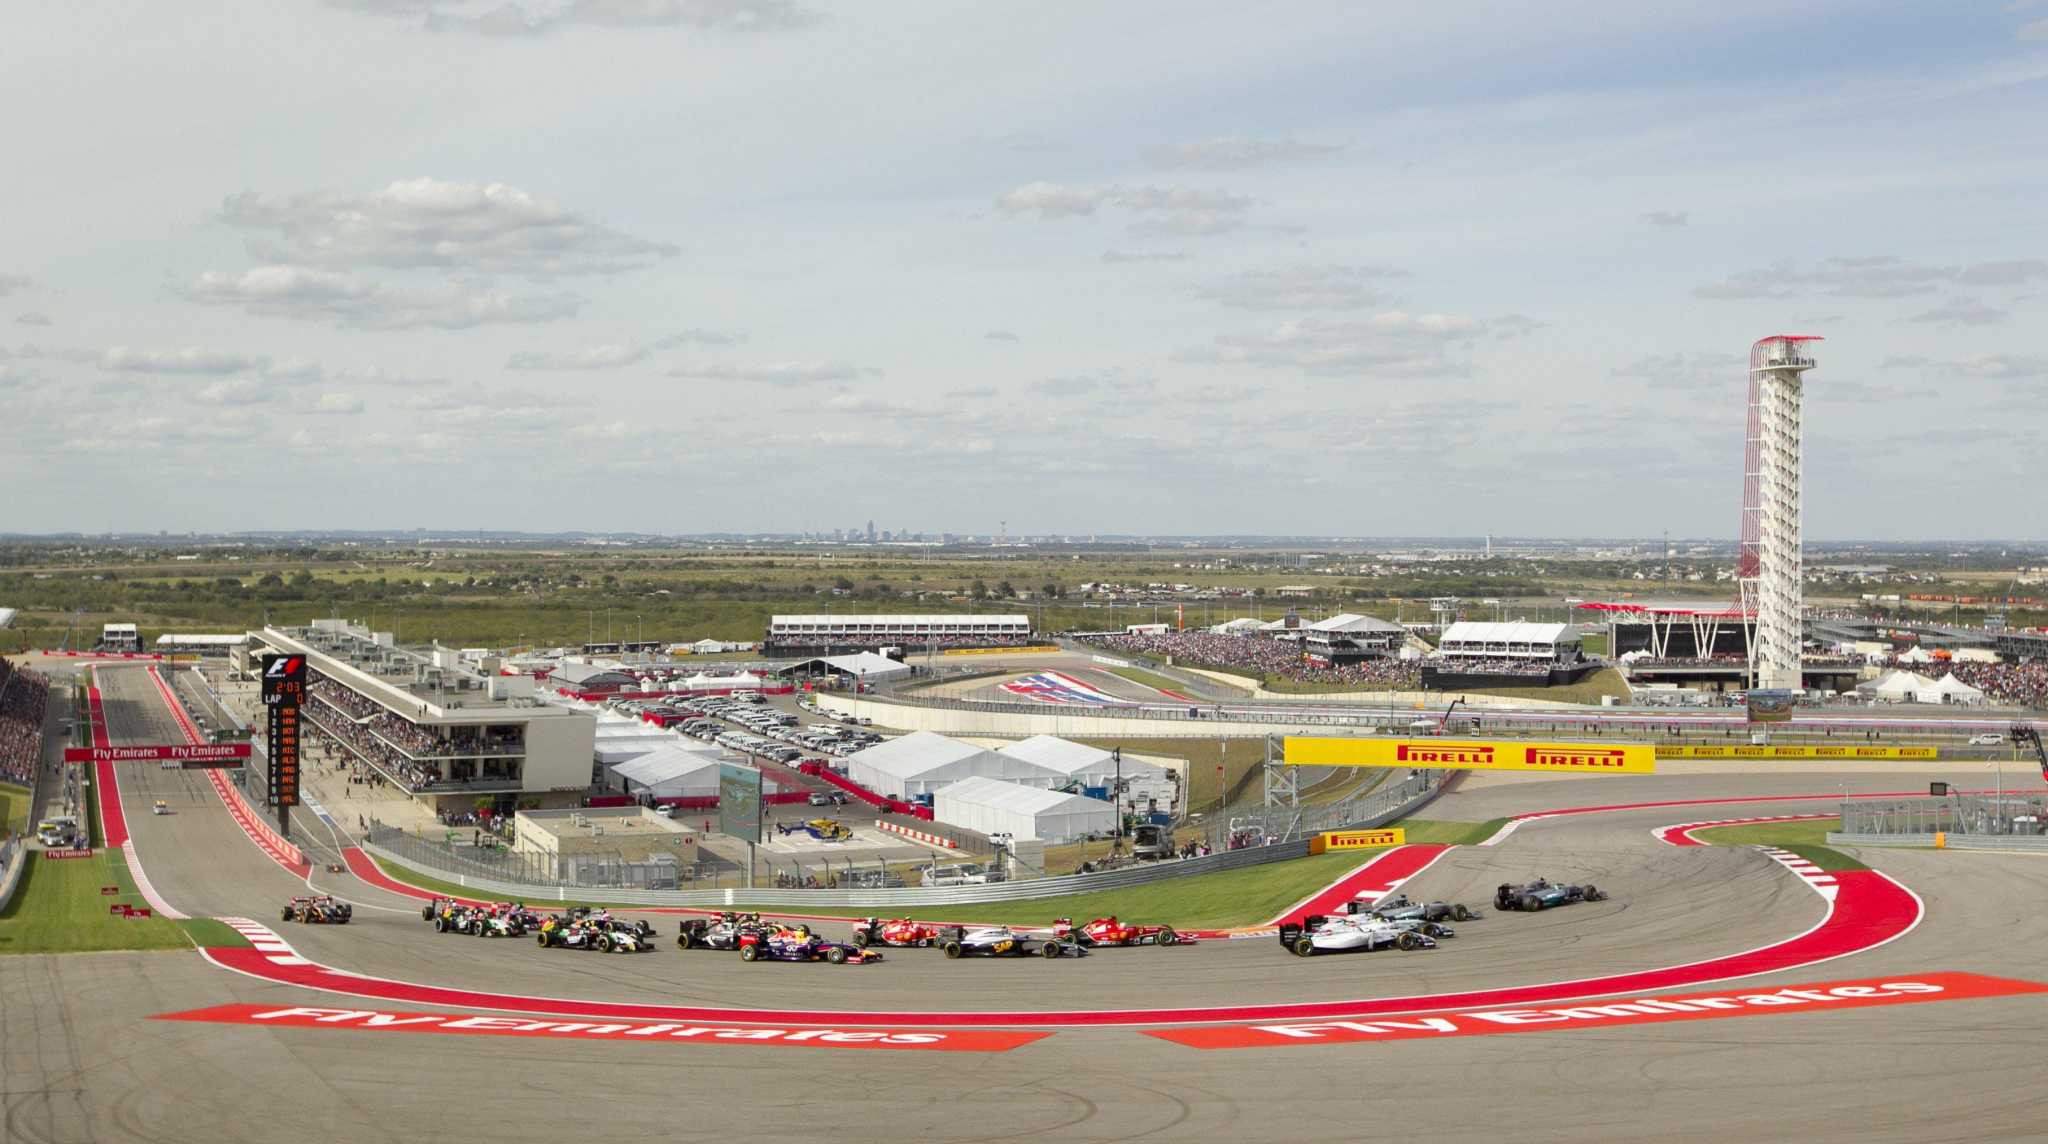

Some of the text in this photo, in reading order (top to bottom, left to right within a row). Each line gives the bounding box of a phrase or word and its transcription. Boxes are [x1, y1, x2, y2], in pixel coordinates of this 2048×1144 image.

[265, 694, 282, 704] LAP
[93, 748, 159, 760] Fly Emirates
[171, 745, 236, 758] Fly Emirates
[1398, 744, 1495, 763] PIRELLI
[1525, 747, 1625, 767] PIRELLI
[1331, 832, 1394, 846] PIRELLI
[48, 850, 60, 858] Fly
[1248, 982, 1945, 1038] Fly Emirates
[250, 1007, 948, 1044] Fly Emirates
